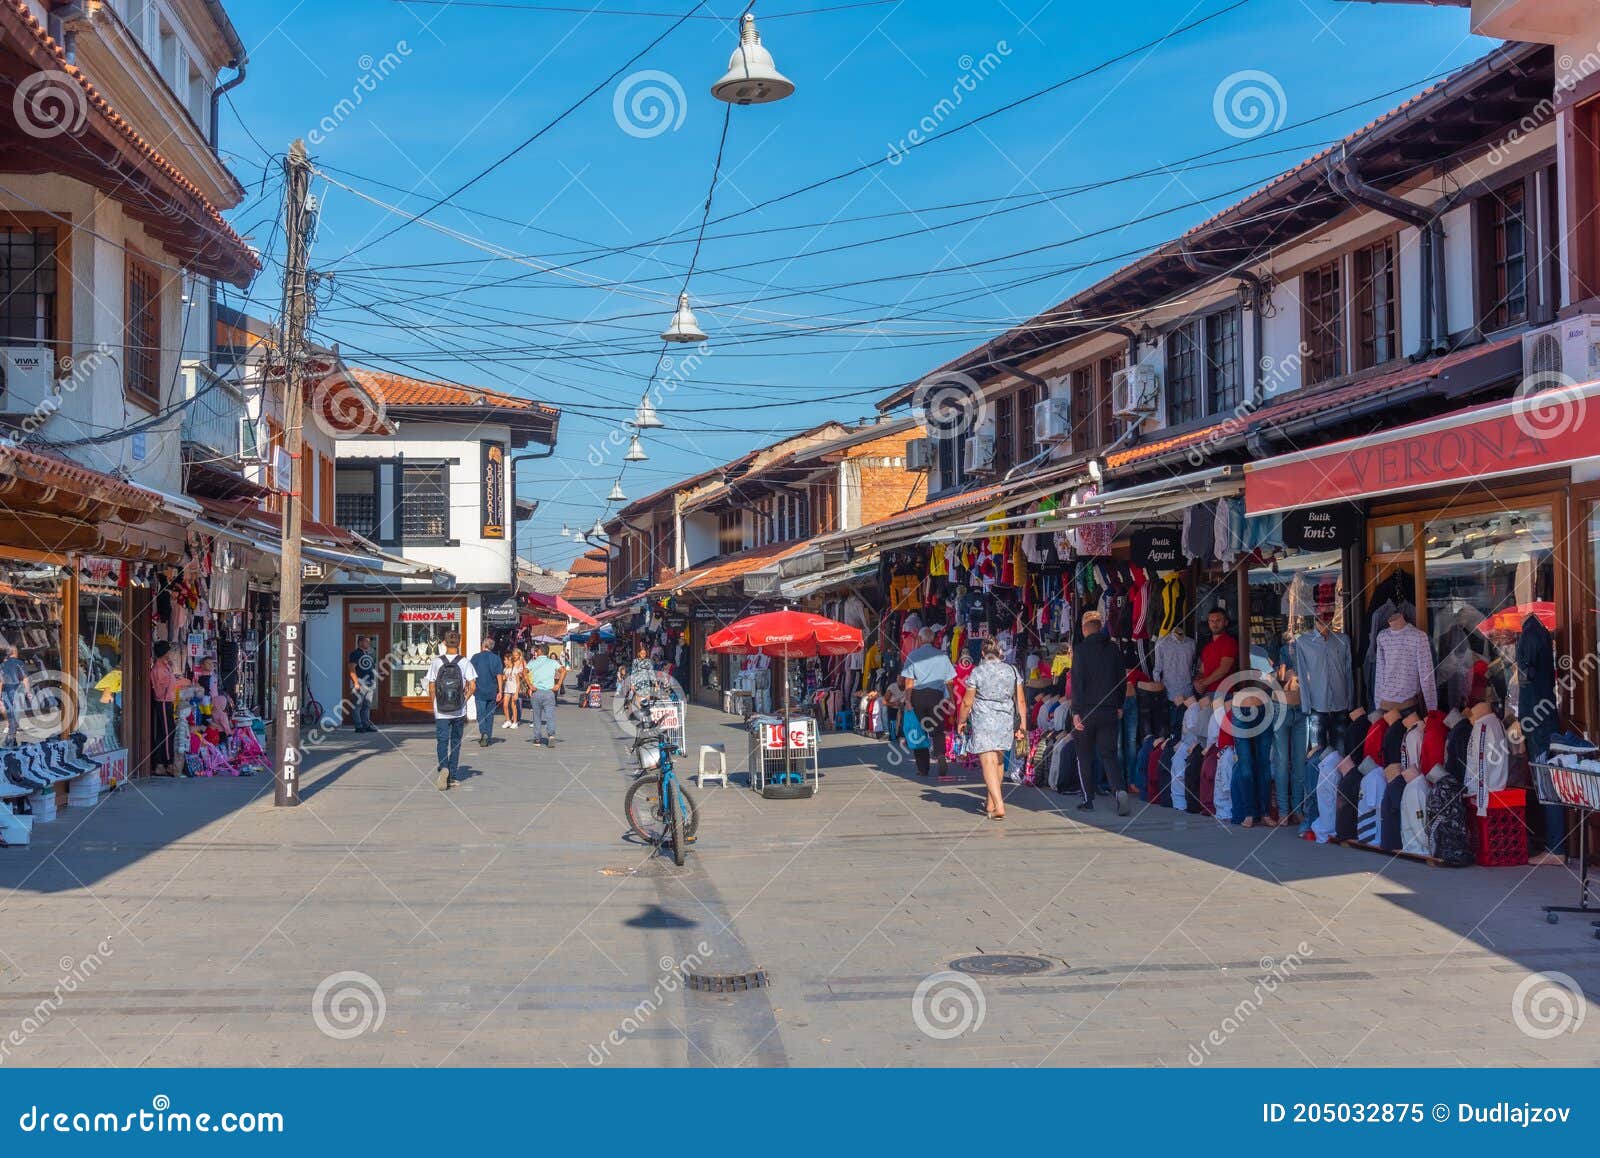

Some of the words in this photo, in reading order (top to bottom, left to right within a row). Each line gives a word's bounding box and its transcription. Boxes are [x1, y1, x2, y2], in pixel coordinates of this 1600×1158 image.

[1349, 420, 1548, 488] VERONA
[1309, 512, 1331, 521] Butik
[1304, 526, 1336, 539] Toni-S
[1152, 537, 1171, 546] Butik
[1147, 549, 1175, 562] Agoni
[283, 747, 296, 798] ARI
